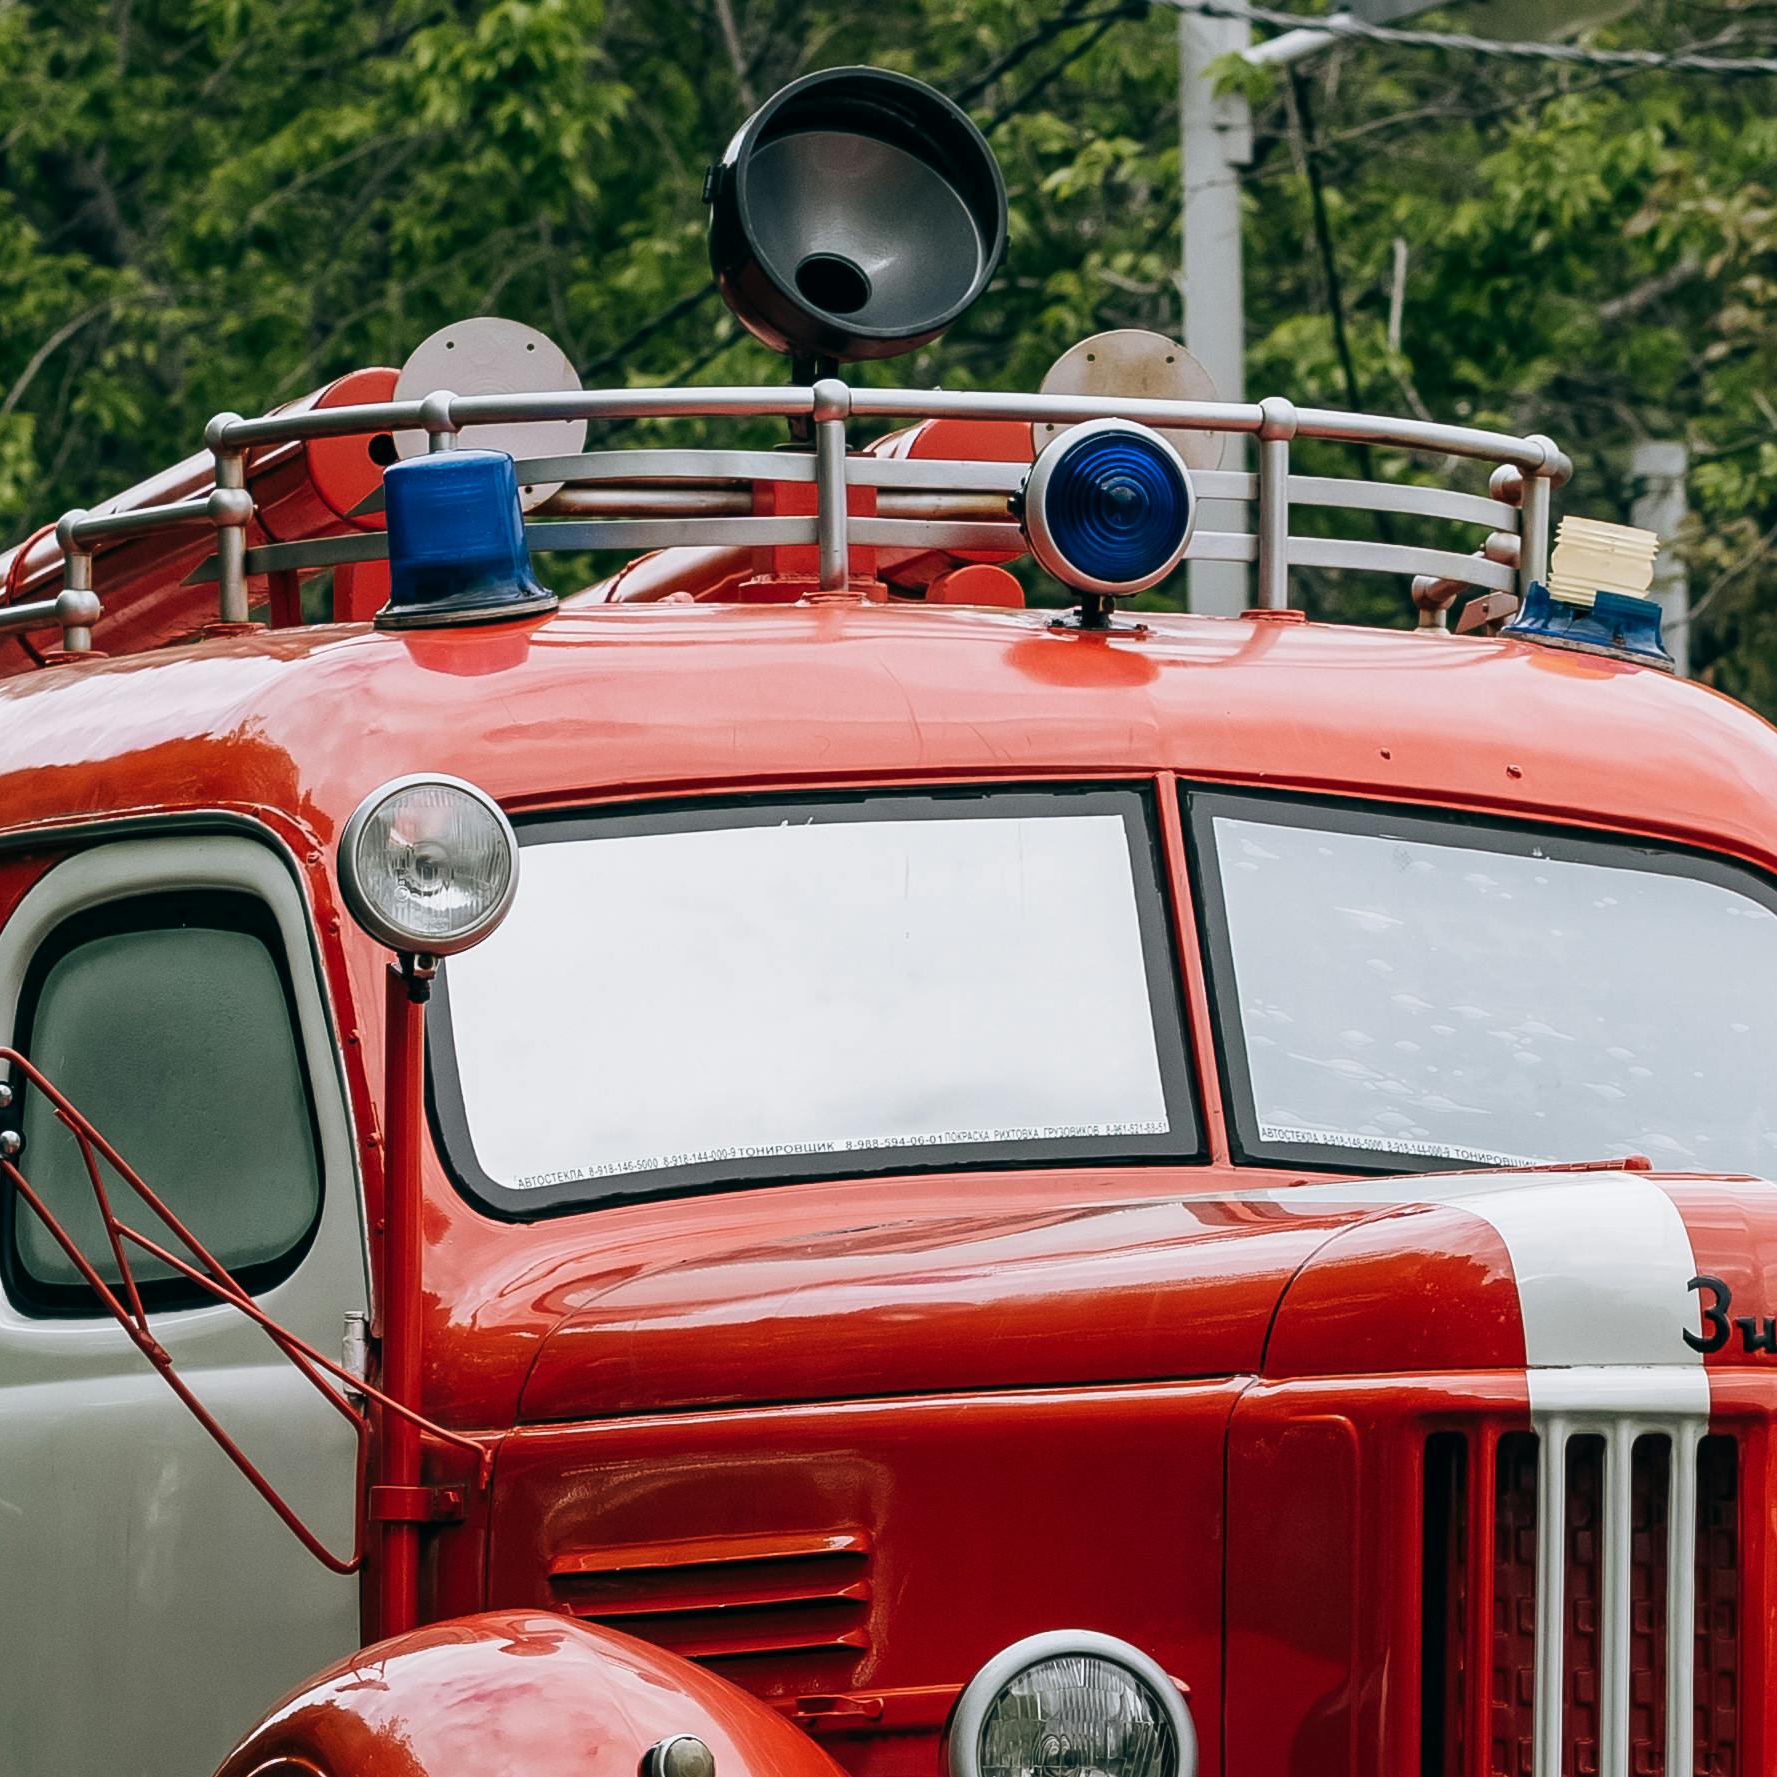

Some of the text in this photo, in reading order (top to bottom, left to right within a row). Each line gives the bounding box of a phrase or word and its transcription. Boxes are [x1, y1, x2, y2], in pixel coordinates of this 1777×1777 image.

[518, 1168, 584, 1188] АВТОСТЕКЛА
[738, 1141, 835, 1157] ТОНИРОВЩИК
[945, 1130, 990, 1143] ПОКРАСКА
[994, 1128, 1039, 1140] РИХТОВКА
[1043, 1125, 1099, 1139] ГРУЗОВИКОВ
